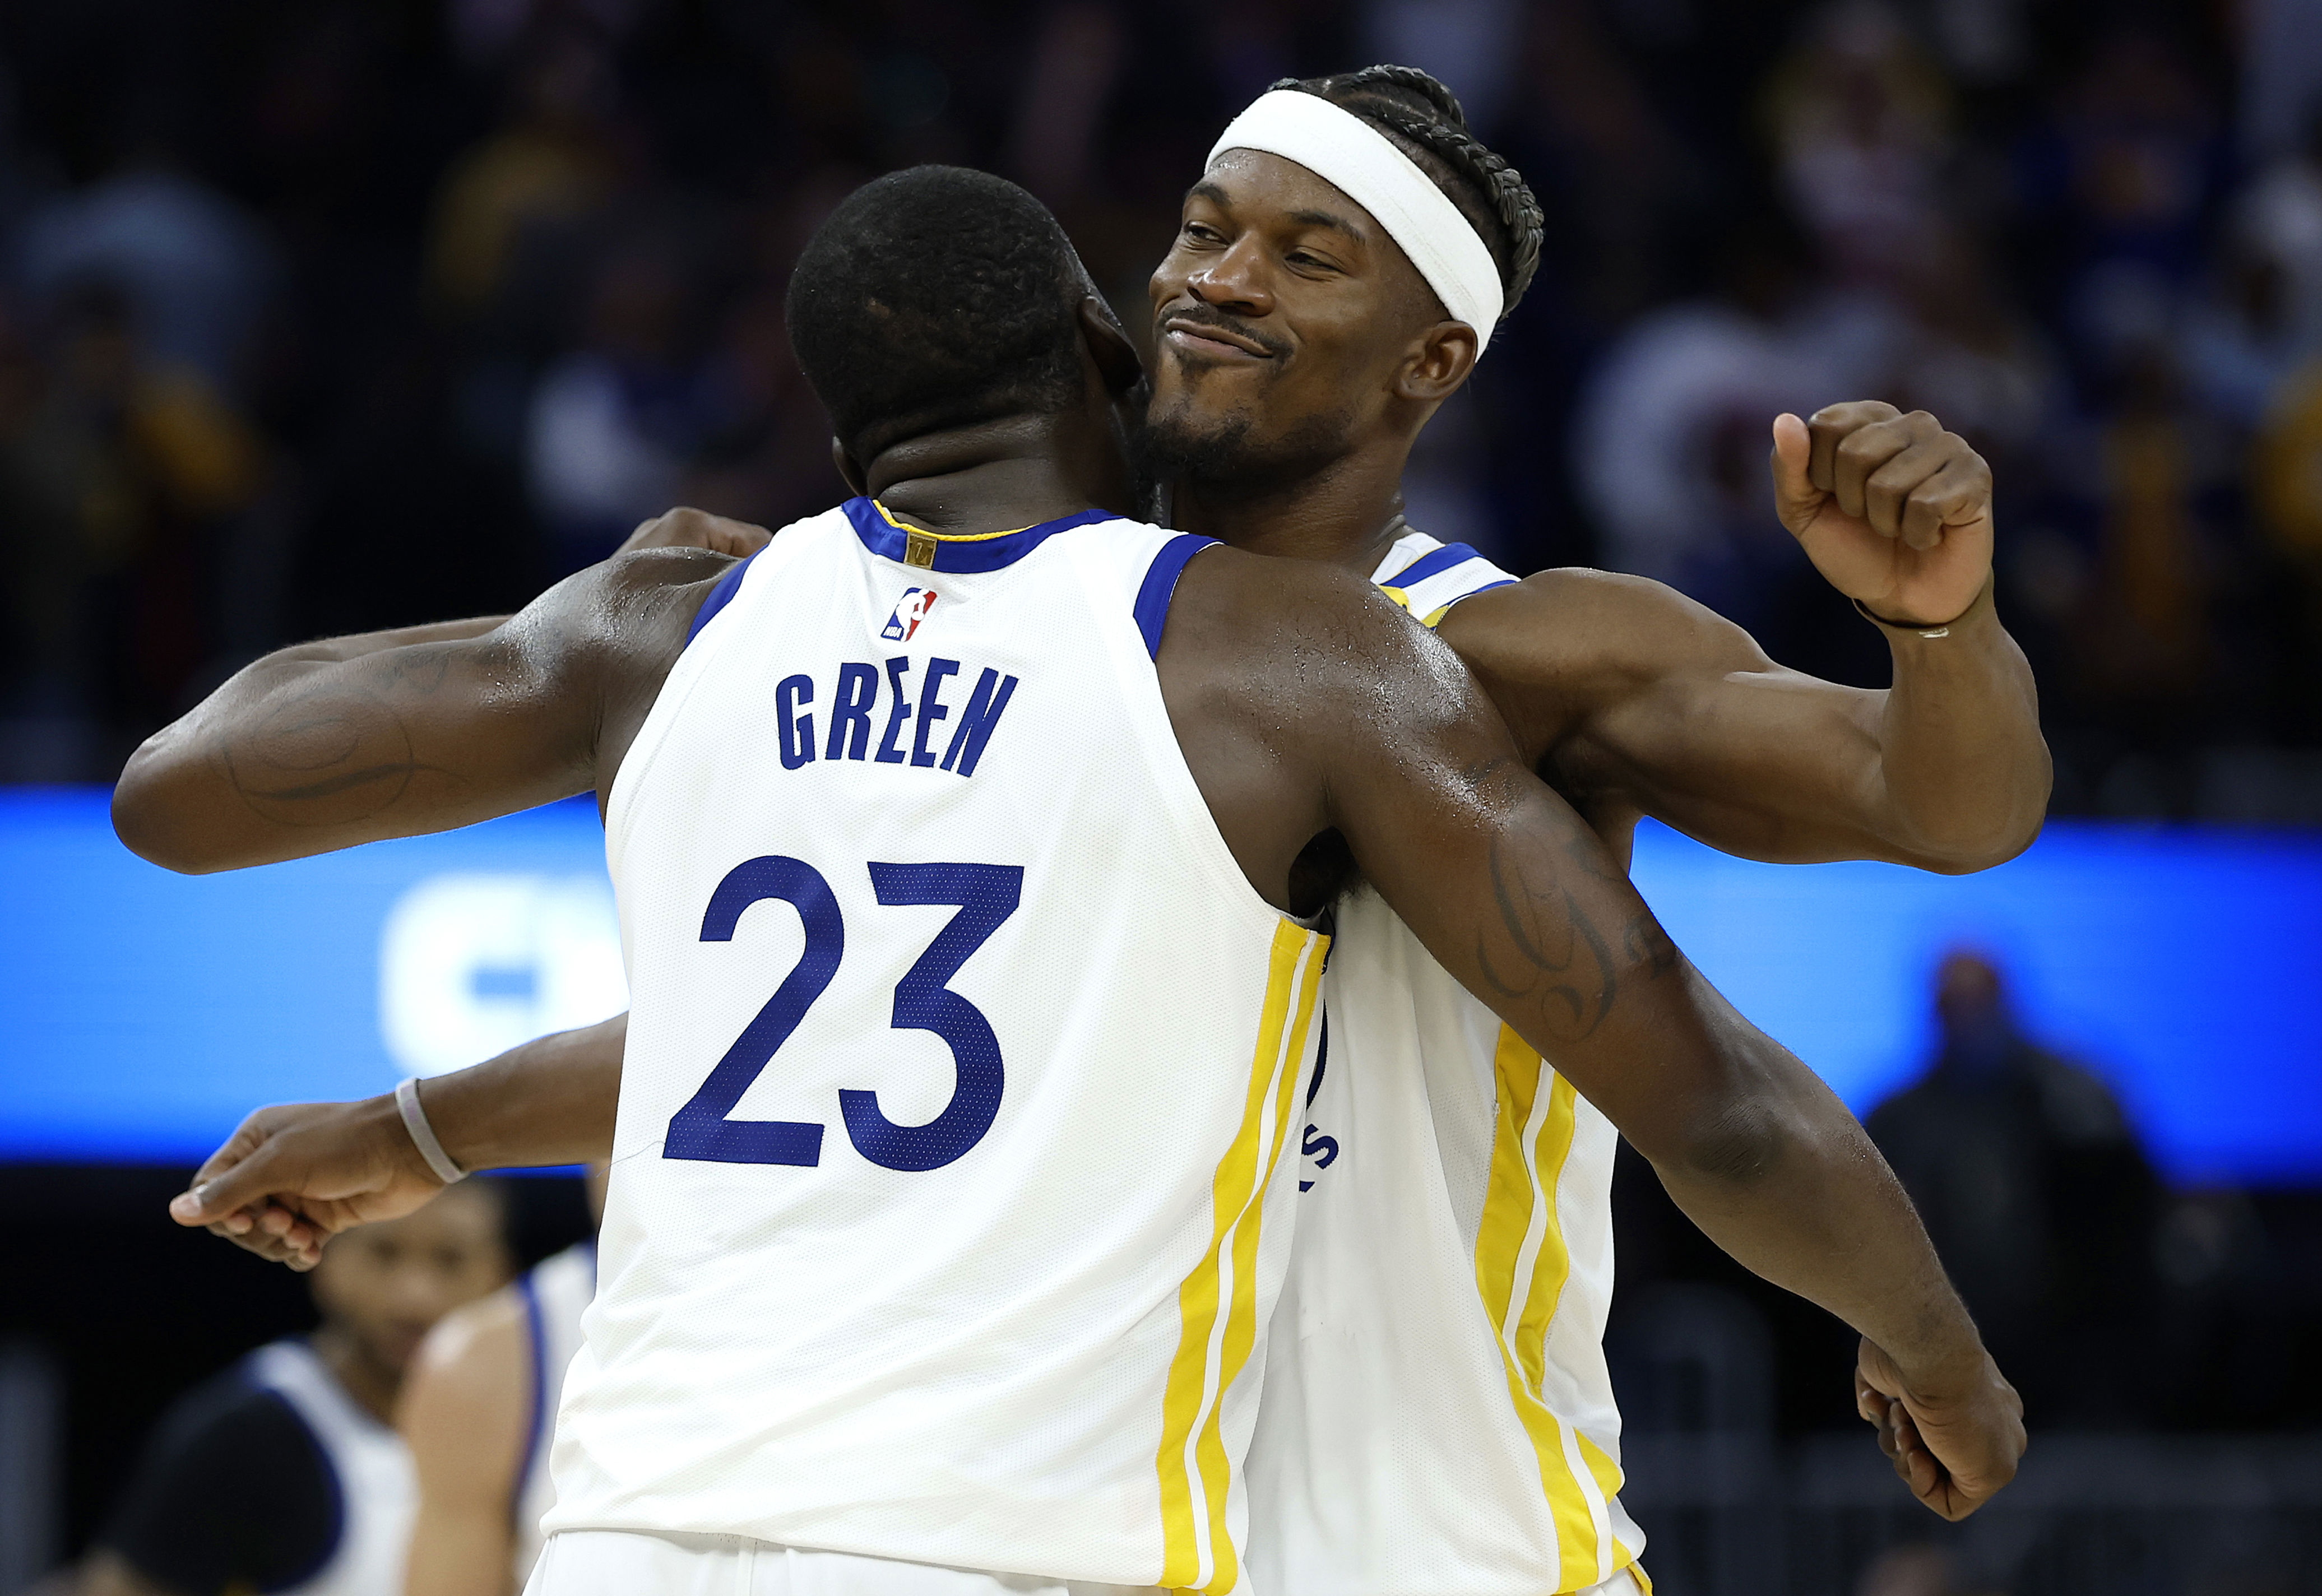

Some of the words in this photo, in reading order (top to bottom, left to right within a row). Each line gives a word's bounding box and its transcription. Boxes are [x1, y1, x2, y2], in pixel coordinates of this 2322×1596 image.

[883, 626, 903, 638] NBA
[776, 656, 1019, 778] GREEN
[662, 855, 1025, 1172] 23
